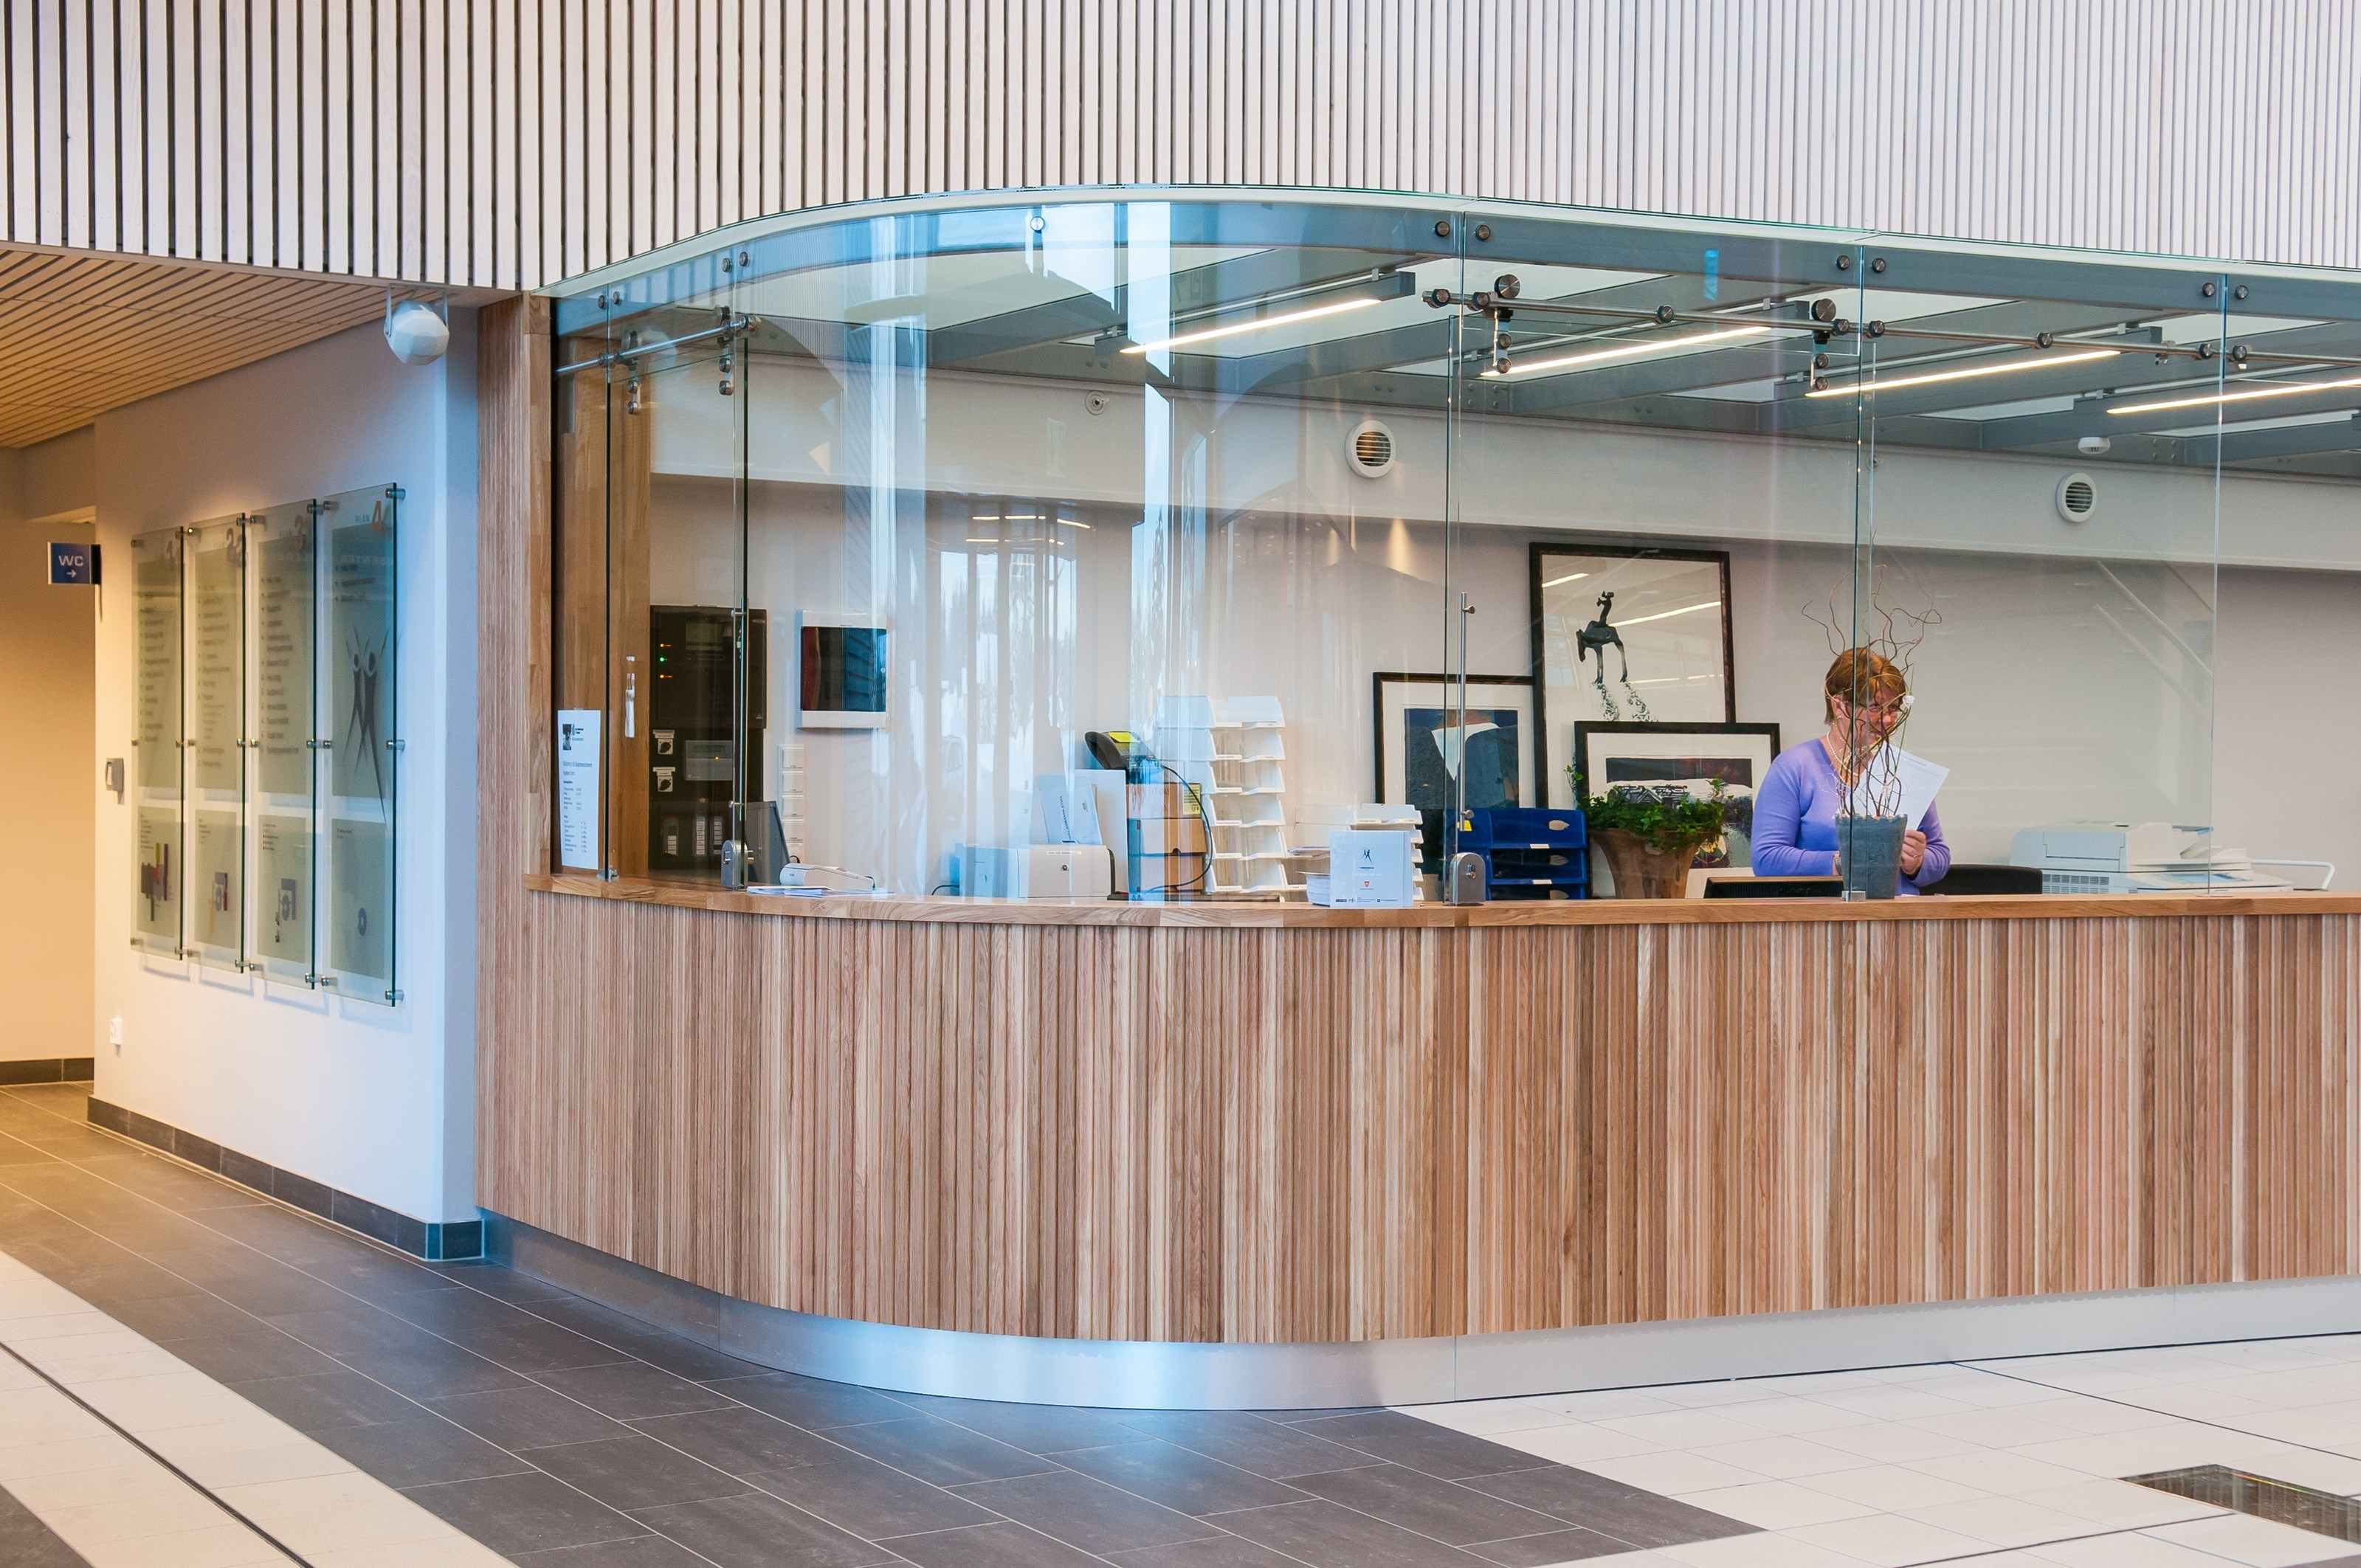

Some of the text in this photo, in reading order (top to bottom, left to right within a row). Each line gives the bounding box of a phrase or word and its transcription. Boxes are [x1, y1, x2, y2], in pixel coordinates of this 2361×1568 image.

[294, 515, 304, 550] 3
[371, 500, 384, 536] 4
[58, 555, 83, 566] WC
[227, 528, 235, 562] 2
